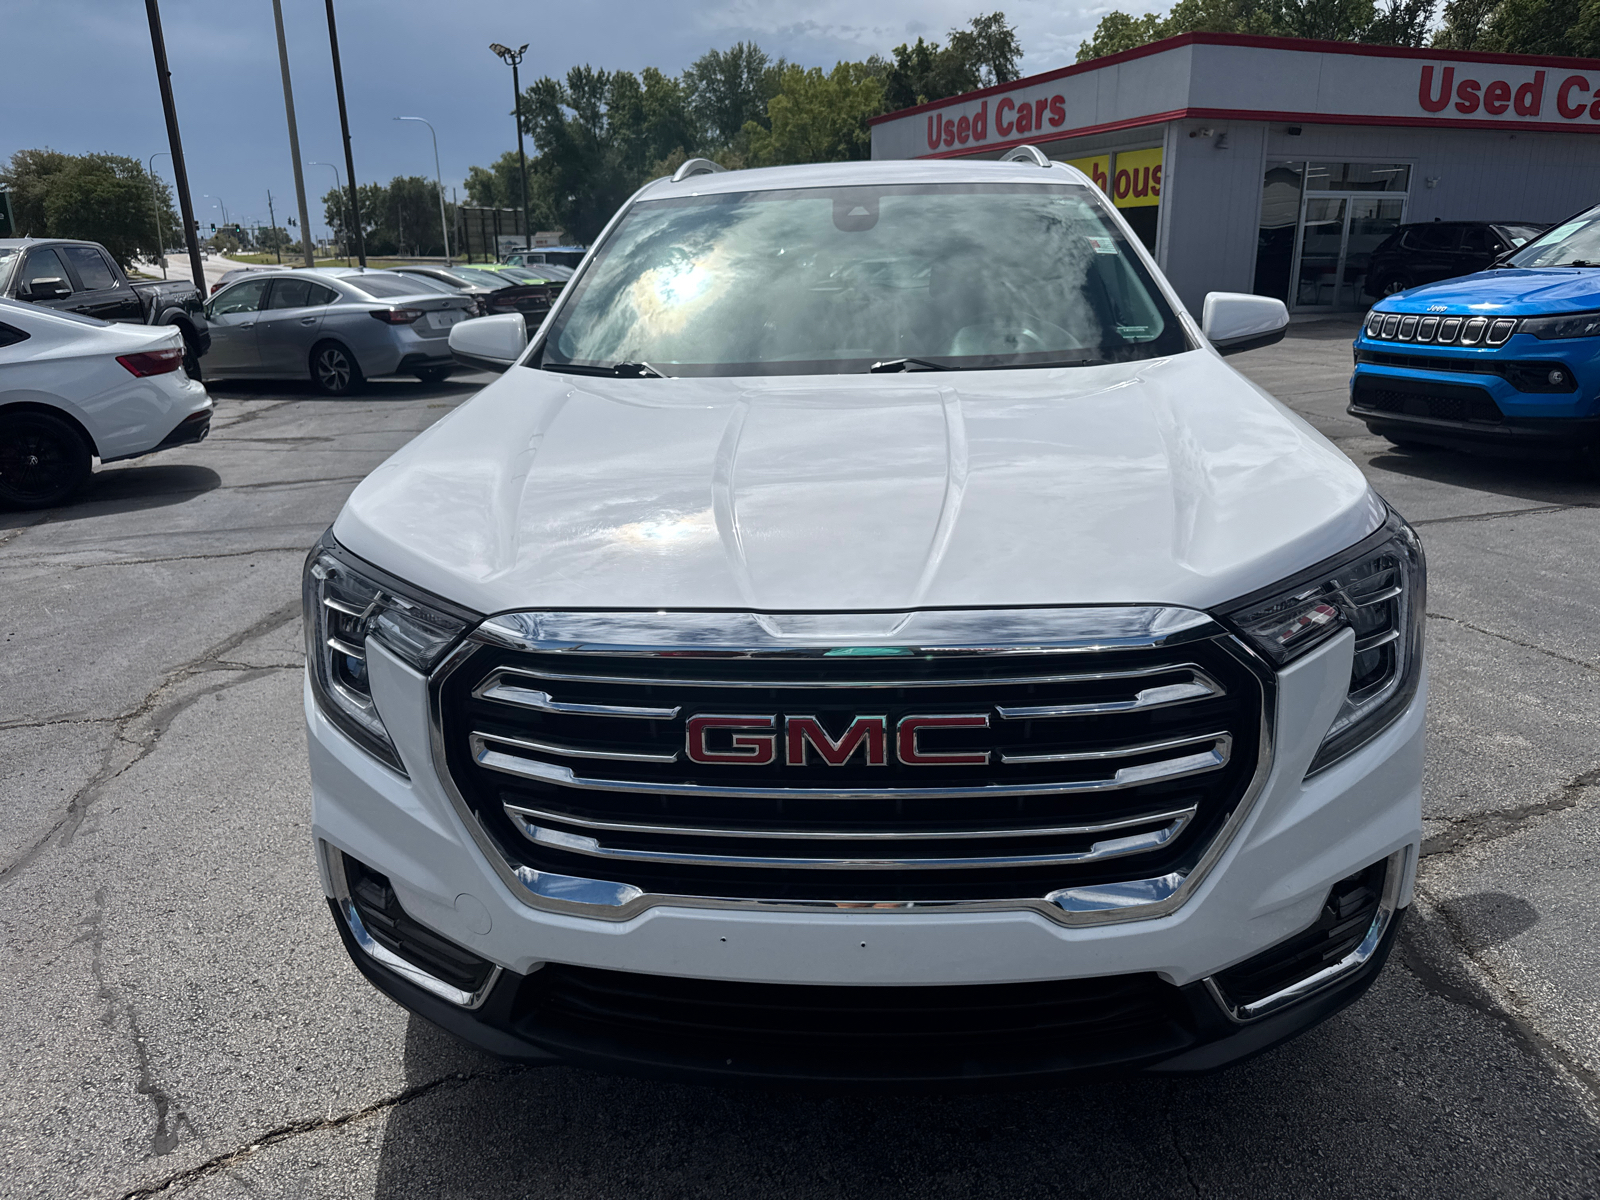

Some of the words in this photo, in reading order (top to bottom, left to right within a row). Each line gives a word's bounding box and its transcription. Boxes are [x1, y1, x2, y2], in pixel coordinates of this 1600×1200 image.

[1418, 65, 1546, 117] Used
[927, 100, 988, 150] Used
[995, 95, 1066, 137] Cars
[1426, 304, 1448, 313] Jeep
[685, 713, 992, 767] GMC
